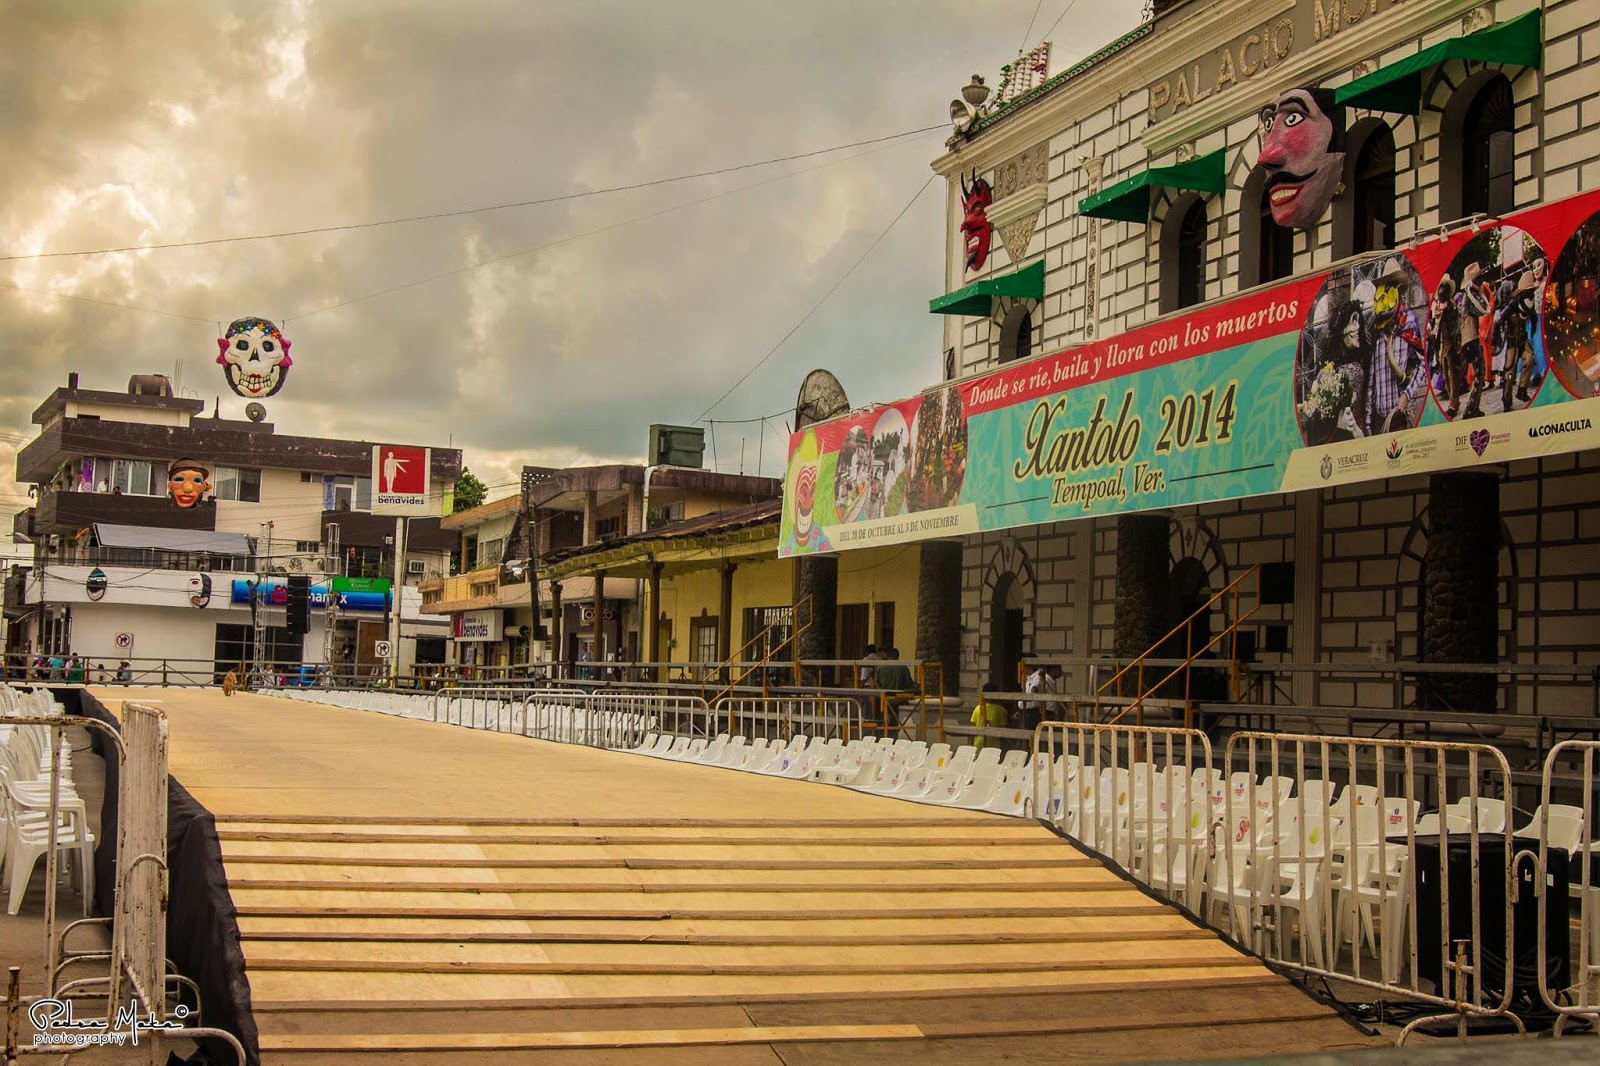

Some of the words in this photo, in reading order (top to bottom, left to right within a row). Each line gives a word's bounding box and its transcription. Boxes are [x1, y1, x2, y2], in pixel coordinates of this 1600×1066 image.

[1148, 18, 1295, 123] PALACIO
[968, 377, 1008, 406] Donde
[1011, 378, 1025, 395] se
[1090, 356, 1102, 380] y
[1106, 344, 1144, 368] llora
[1149, 334, 1179, 357] con
[1184, 322, 1211, 347] los
[1216, 300, 1299, 338] muertos
[1014, 389, 1141, 480] Xantolo
[1155, 382, 1237, 452] 2014
[1455, 435, 1468, 447] DIF
[1538, 418, 1592, 437] CONACULTA
[1337, 452, 1369, 466] VERACRUZ
[1052, 467, 1127, 508] Tempoal,
[1132, 463, 1165, 493] Ver.
[378, 496, 425, 505] benavides
[840, 530, 850, 542] DEL
[858, 528, 867, 540] DE
[867, 525, 896, 538] OCTUBRE
[897, 523, 905, 534] AL
[910, 520, 919, 533] DE
[919, 515, 959, 531] NOVIEMBRE
